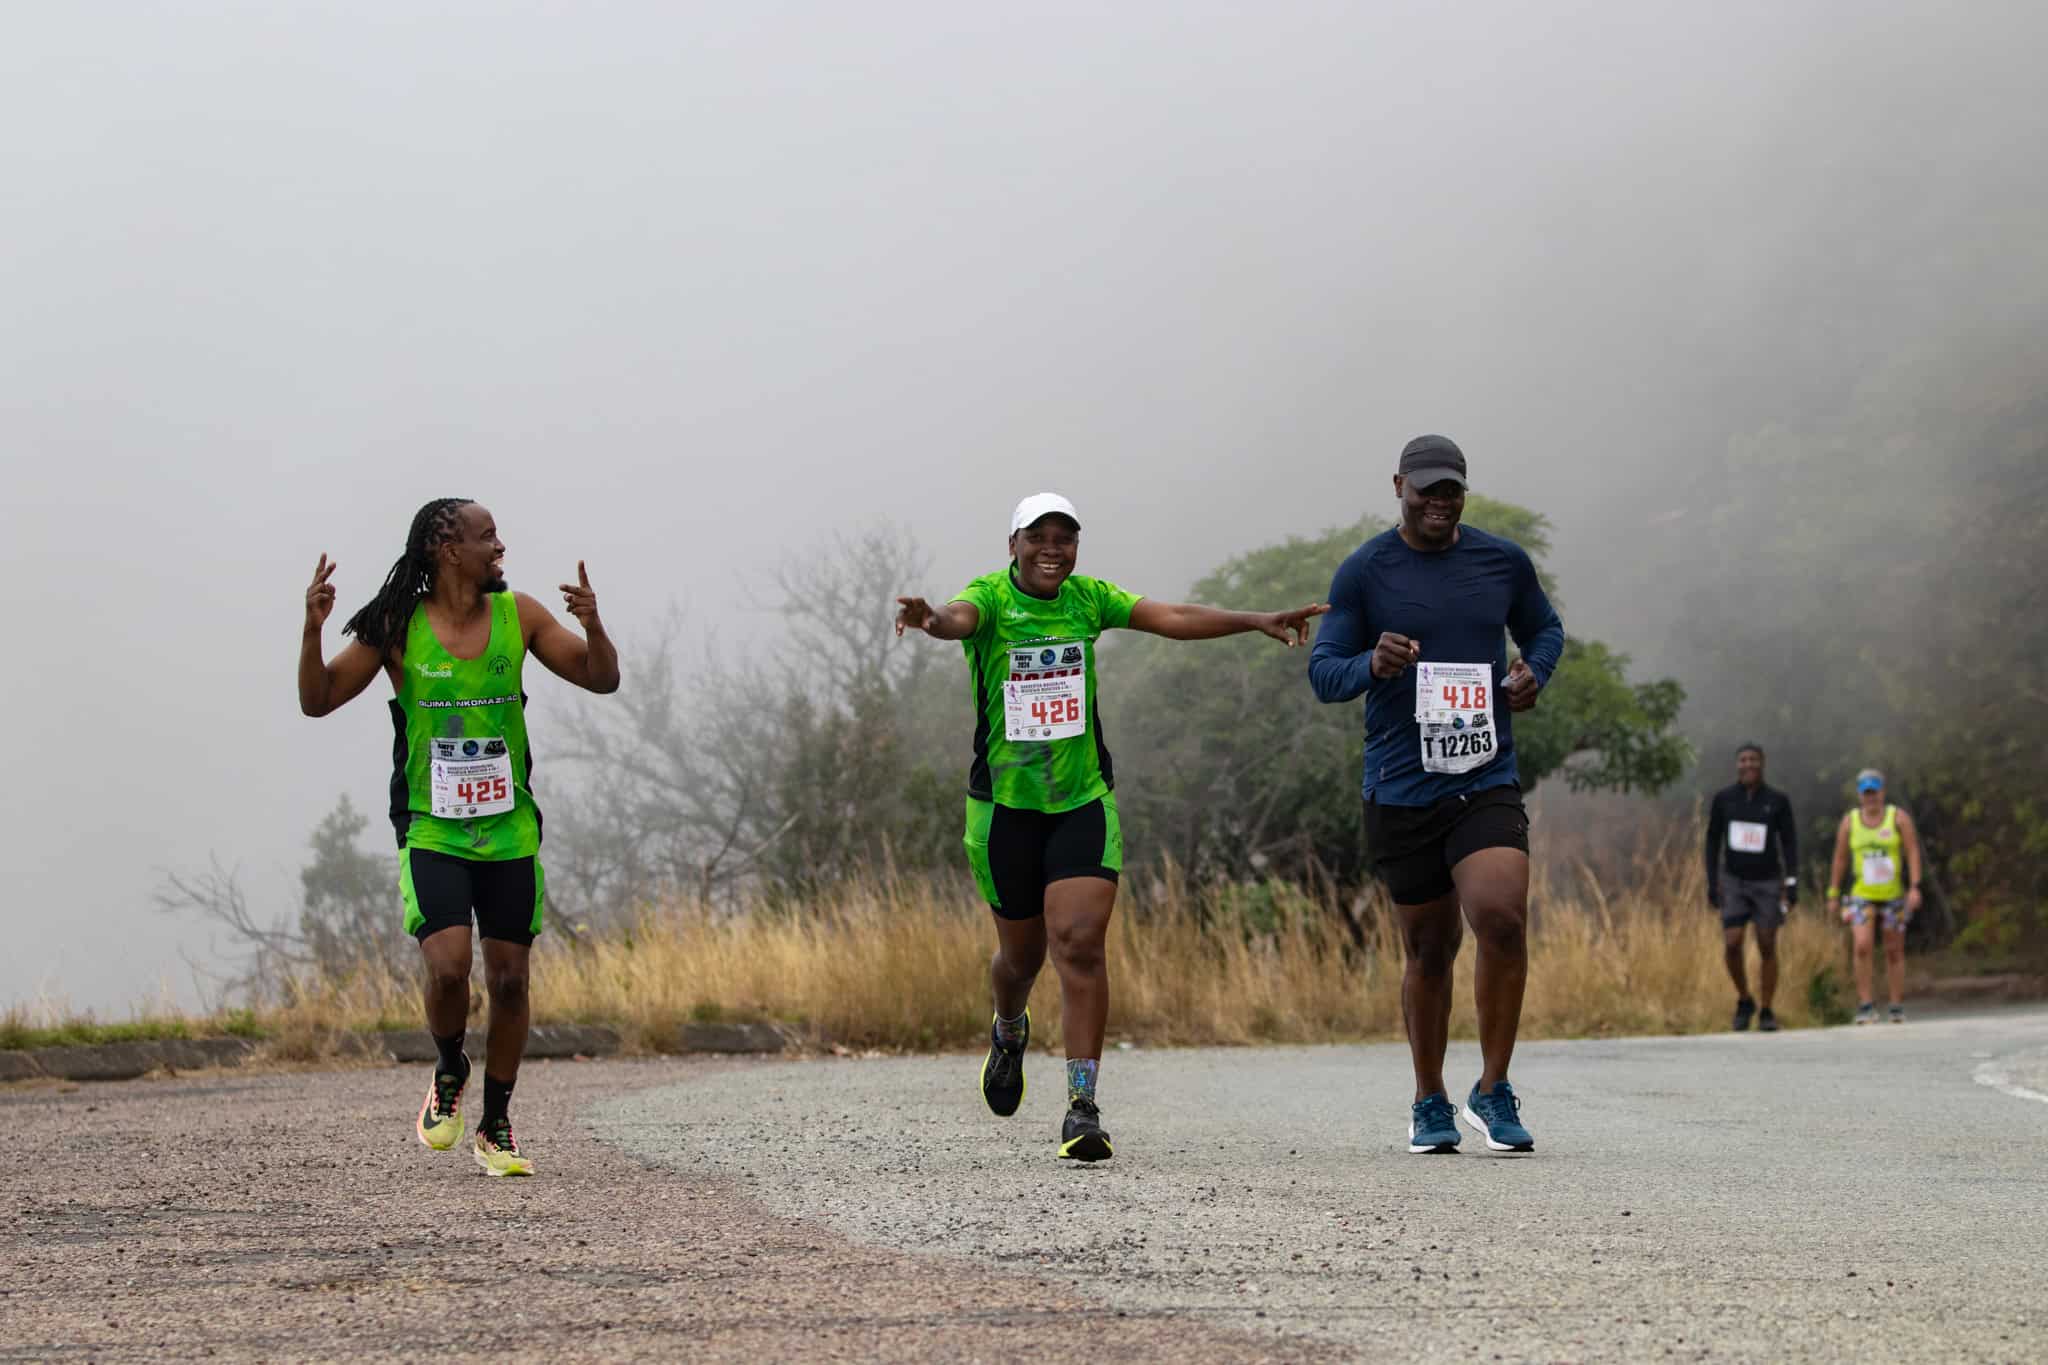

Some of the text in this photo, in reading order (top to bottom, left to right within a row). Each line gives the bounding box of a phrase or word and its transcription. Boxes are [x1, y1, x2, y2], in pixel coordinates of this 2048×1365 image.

[1443, 686, 1486, 709] 418
[1031, 698, 1079, 725] 426
[457, 778, 507, 804] 425
